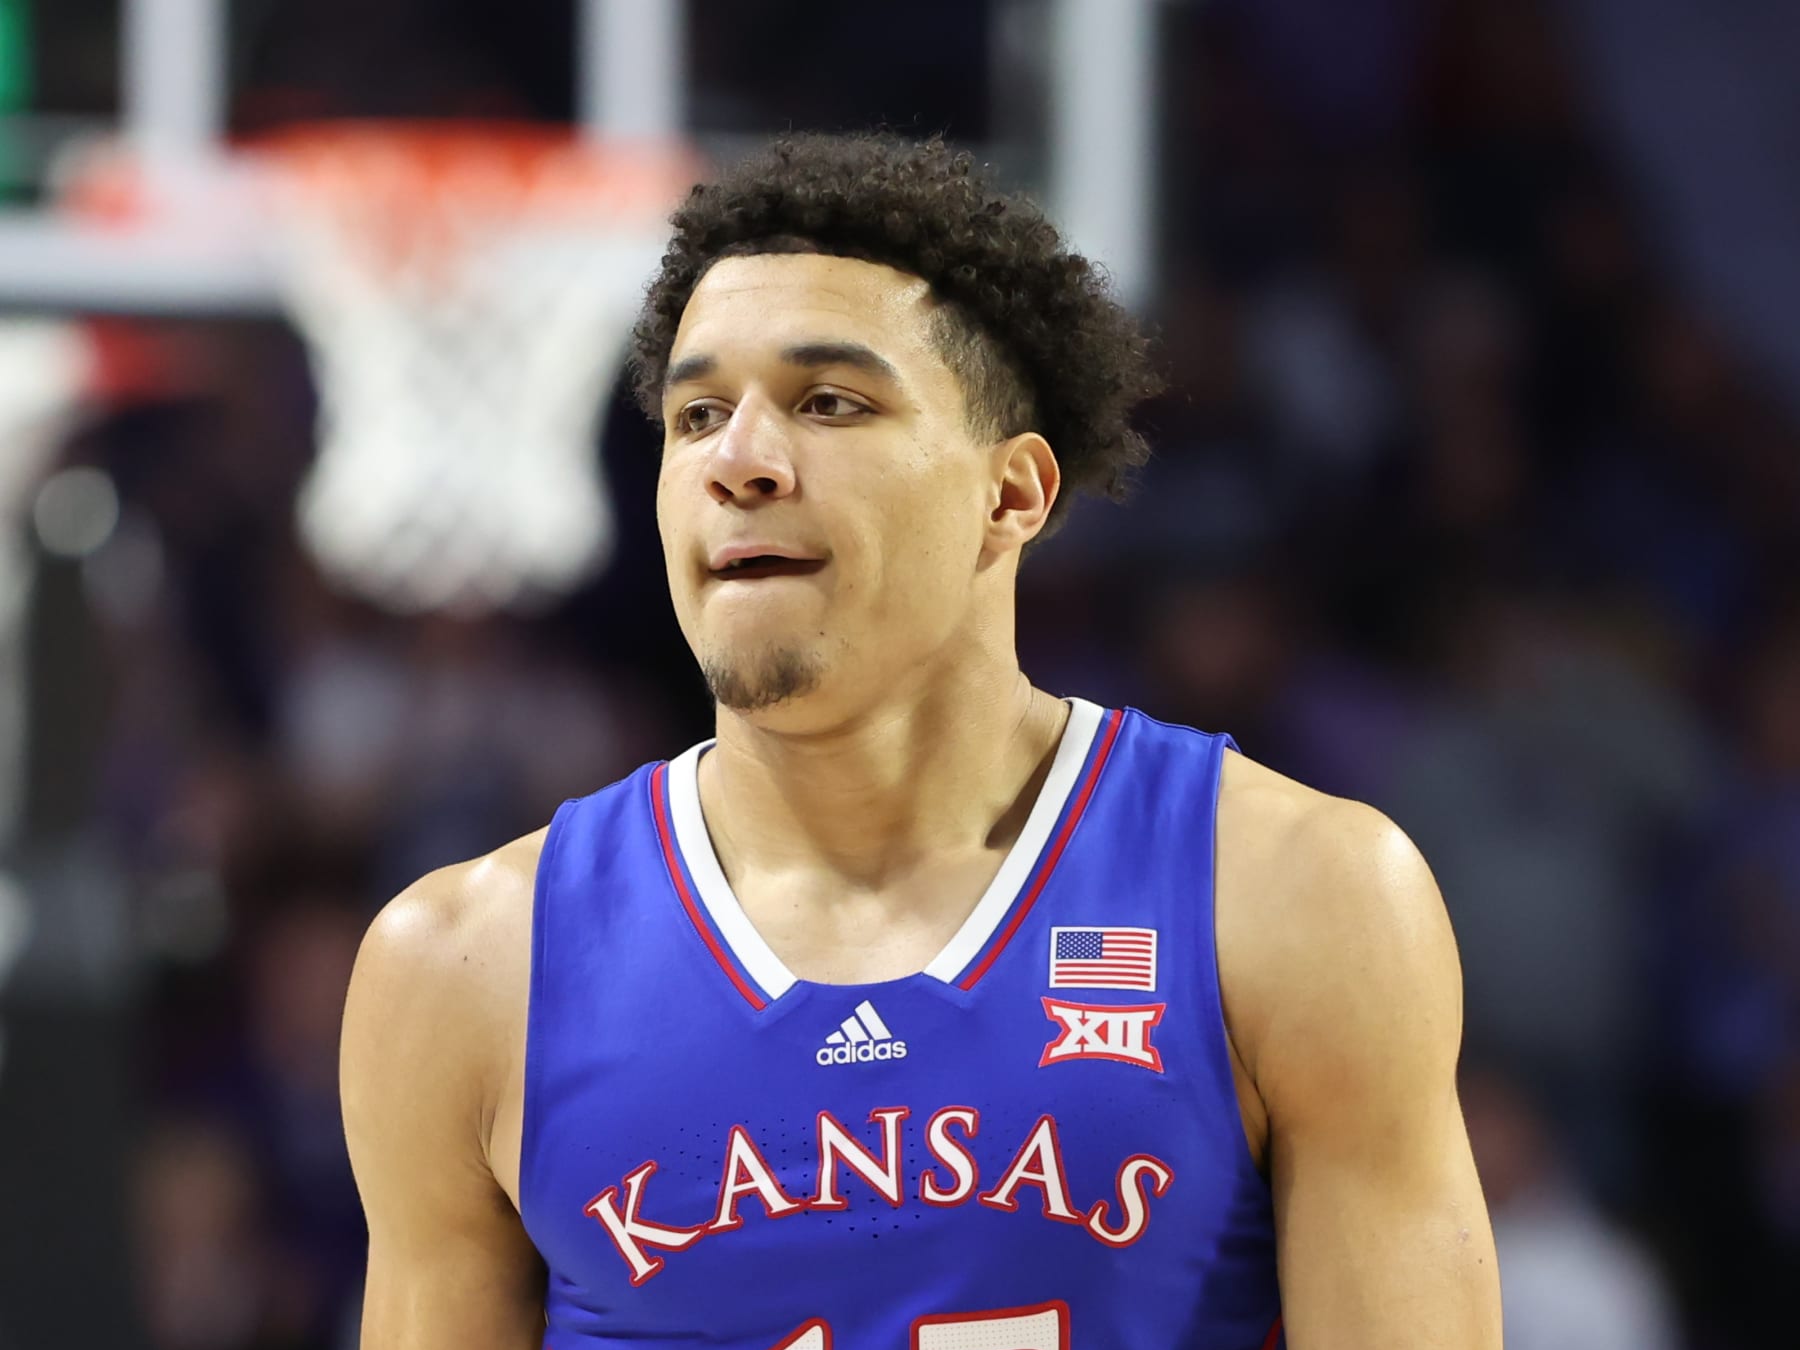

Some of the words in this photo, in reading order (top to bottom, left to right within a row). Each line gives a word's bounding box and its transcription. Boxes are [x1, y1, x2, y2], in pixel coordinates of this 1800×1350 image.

[816, 1038, 908, 1066] adidas
[1046, 1003, 1159, 1066] XII
[584, 1105, 1174, 1286] KANSAS
